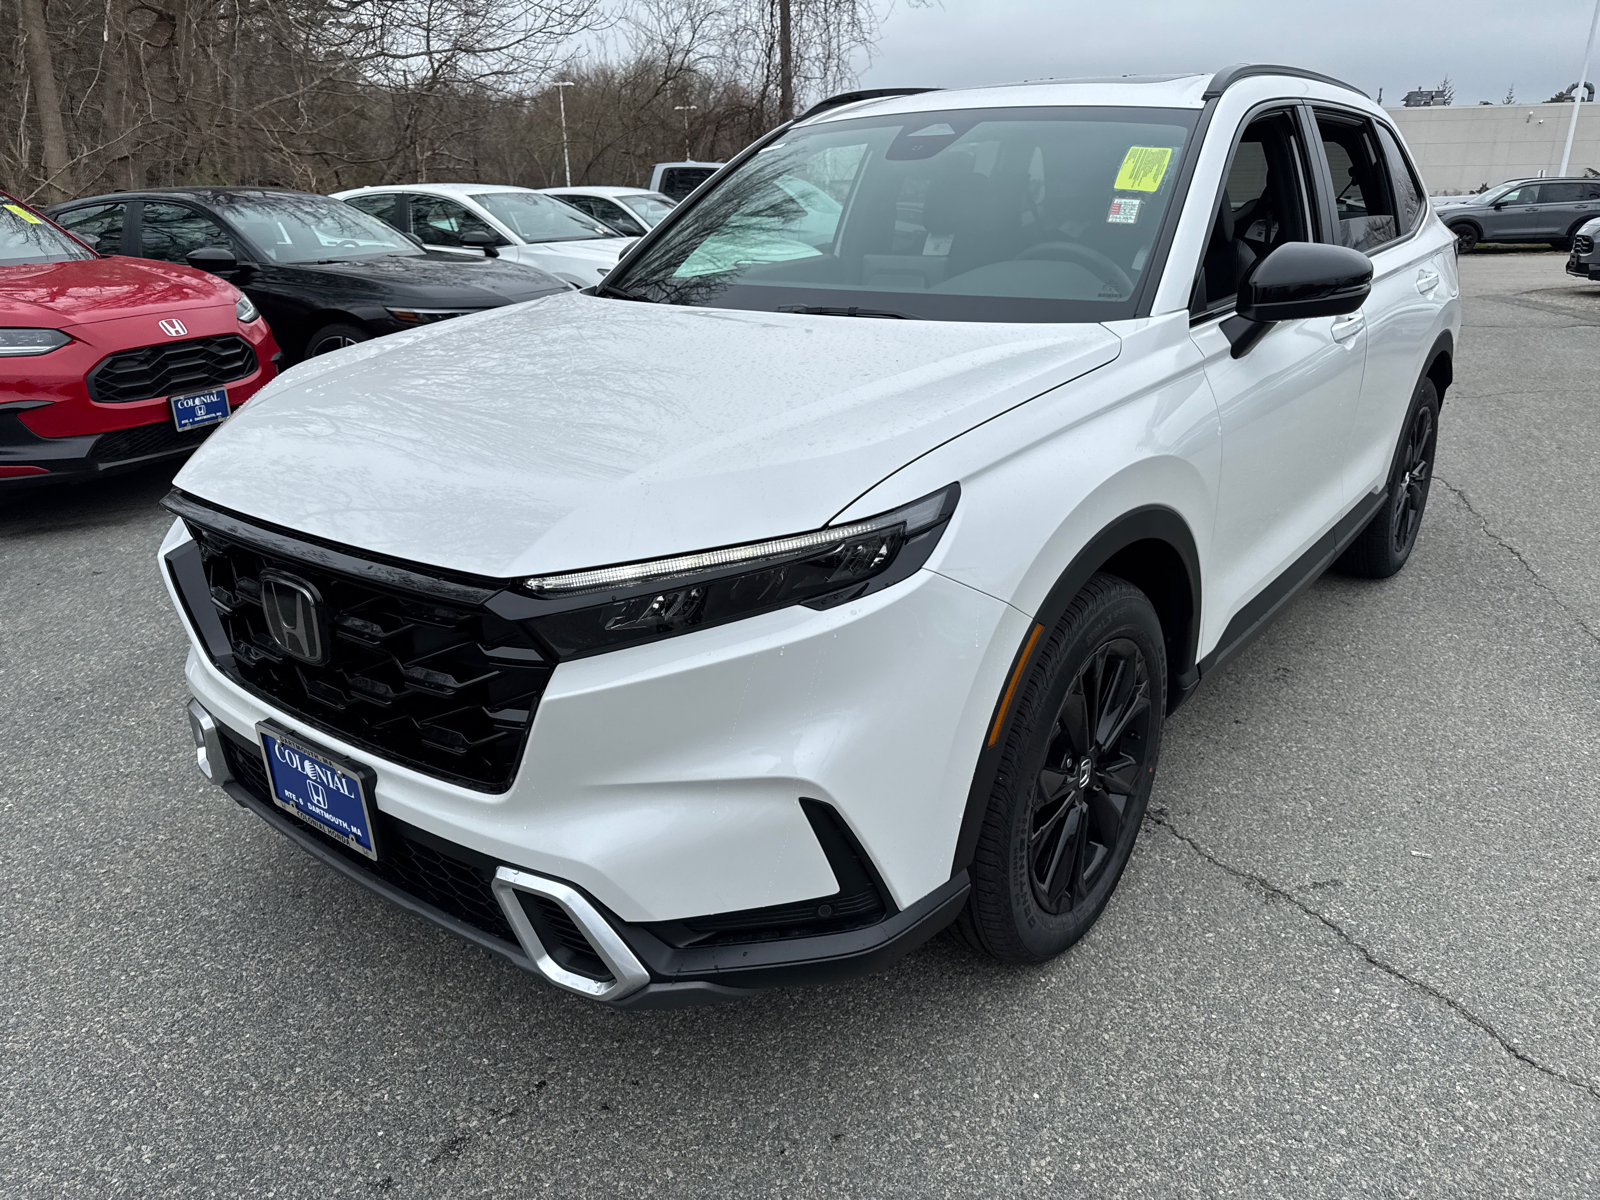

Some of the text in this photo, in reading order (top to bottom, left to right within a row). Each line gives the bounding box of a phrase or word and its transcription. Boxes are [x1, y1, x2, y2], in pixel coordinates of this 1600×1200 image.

[178, 394, 220, 409] COLONIAL
[275, 742, 355, 799] COLONIAL
[297, 810, 327, 831] COLONIAL
[307, 802, 350, 832] DARTMOUTH,
[350, 825, 362, 837] MA
